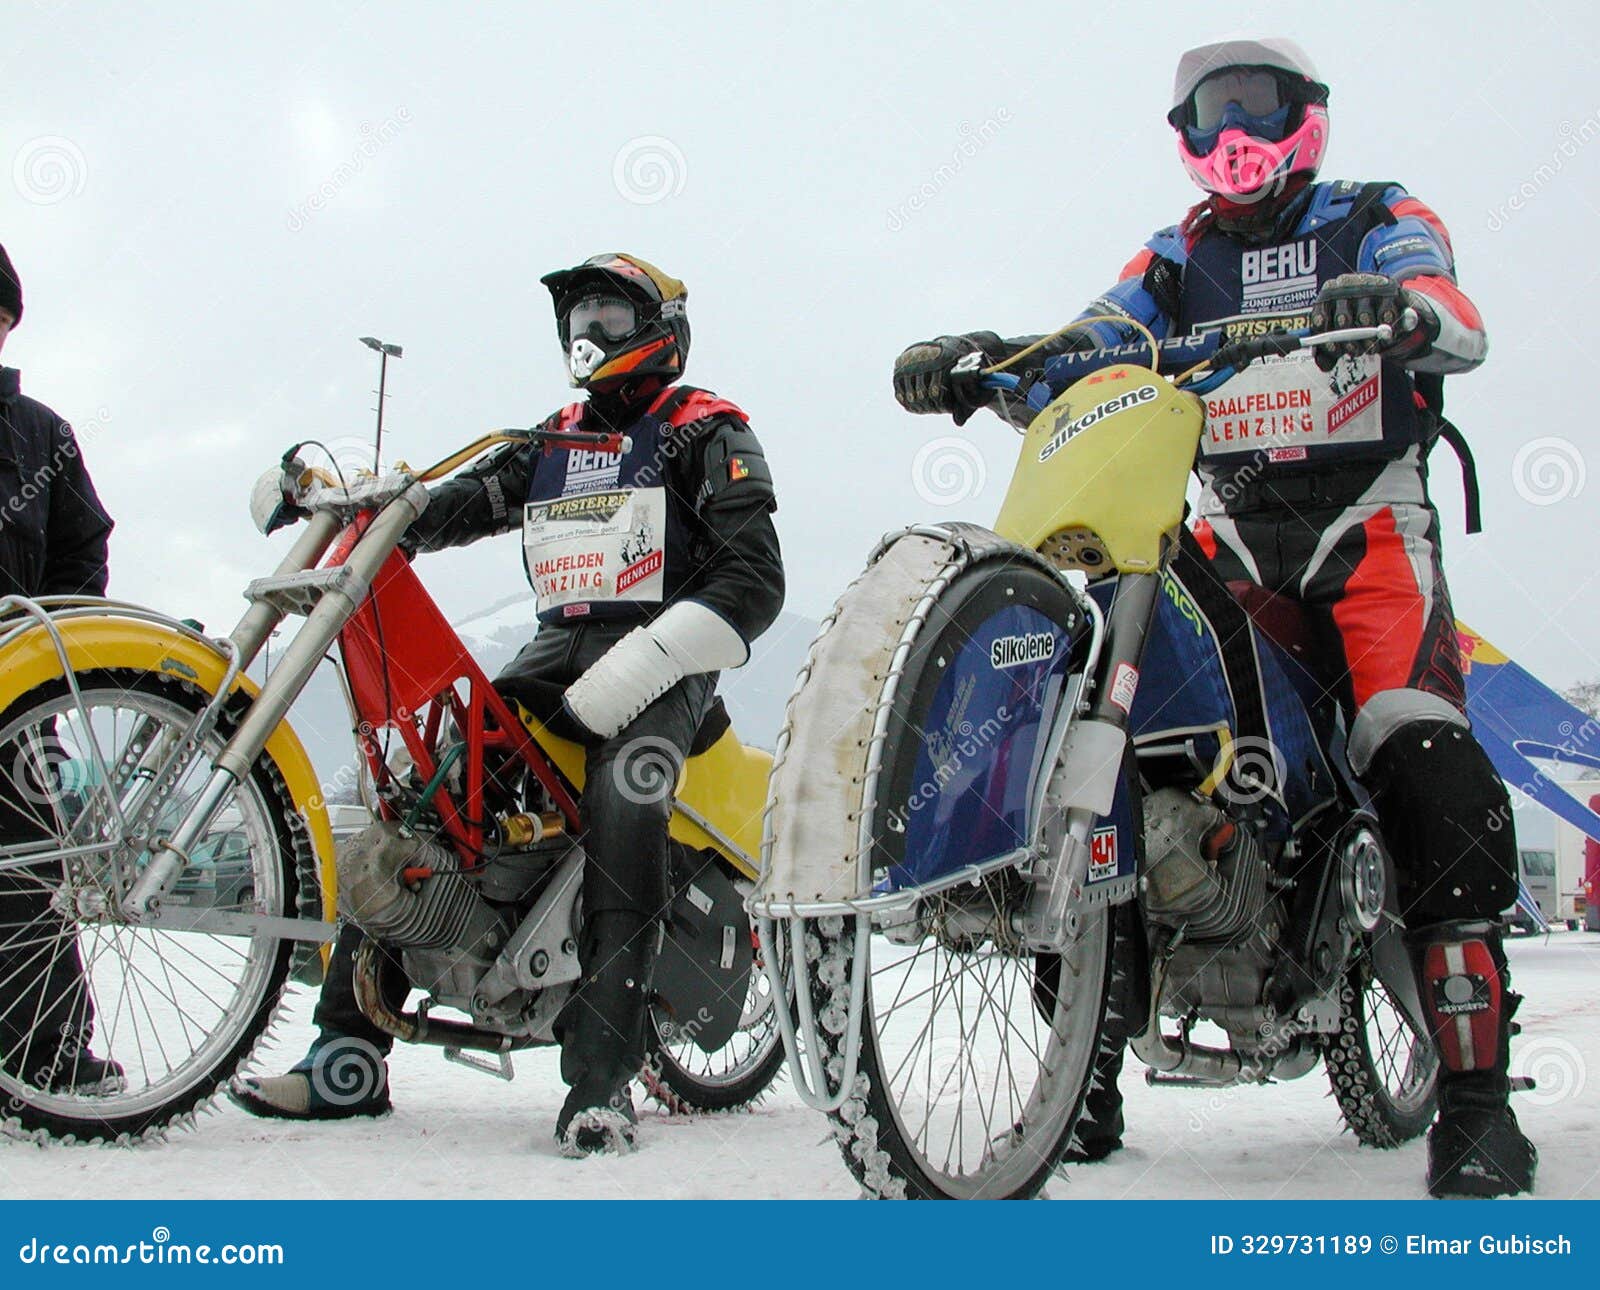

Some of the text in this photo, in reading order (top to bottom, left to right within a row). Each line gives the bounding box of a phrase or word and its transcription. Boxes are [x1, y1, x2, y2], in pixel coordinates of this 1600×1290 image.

[1242, 239, 1317, 285] BERU
[1208, 388, 1311, 419] SAALFELDEN
[1330, 383, 1377, 428] HENKELL
[1039, 385, 1157, 462] Silkolene
[1210, 413, 1313, 443] LENZING
[535, 552, 604, 578] SAALFELDEN
[619, 556, 660, 589] HENKELL
[992, 633, 1053, 666] Silkolene
